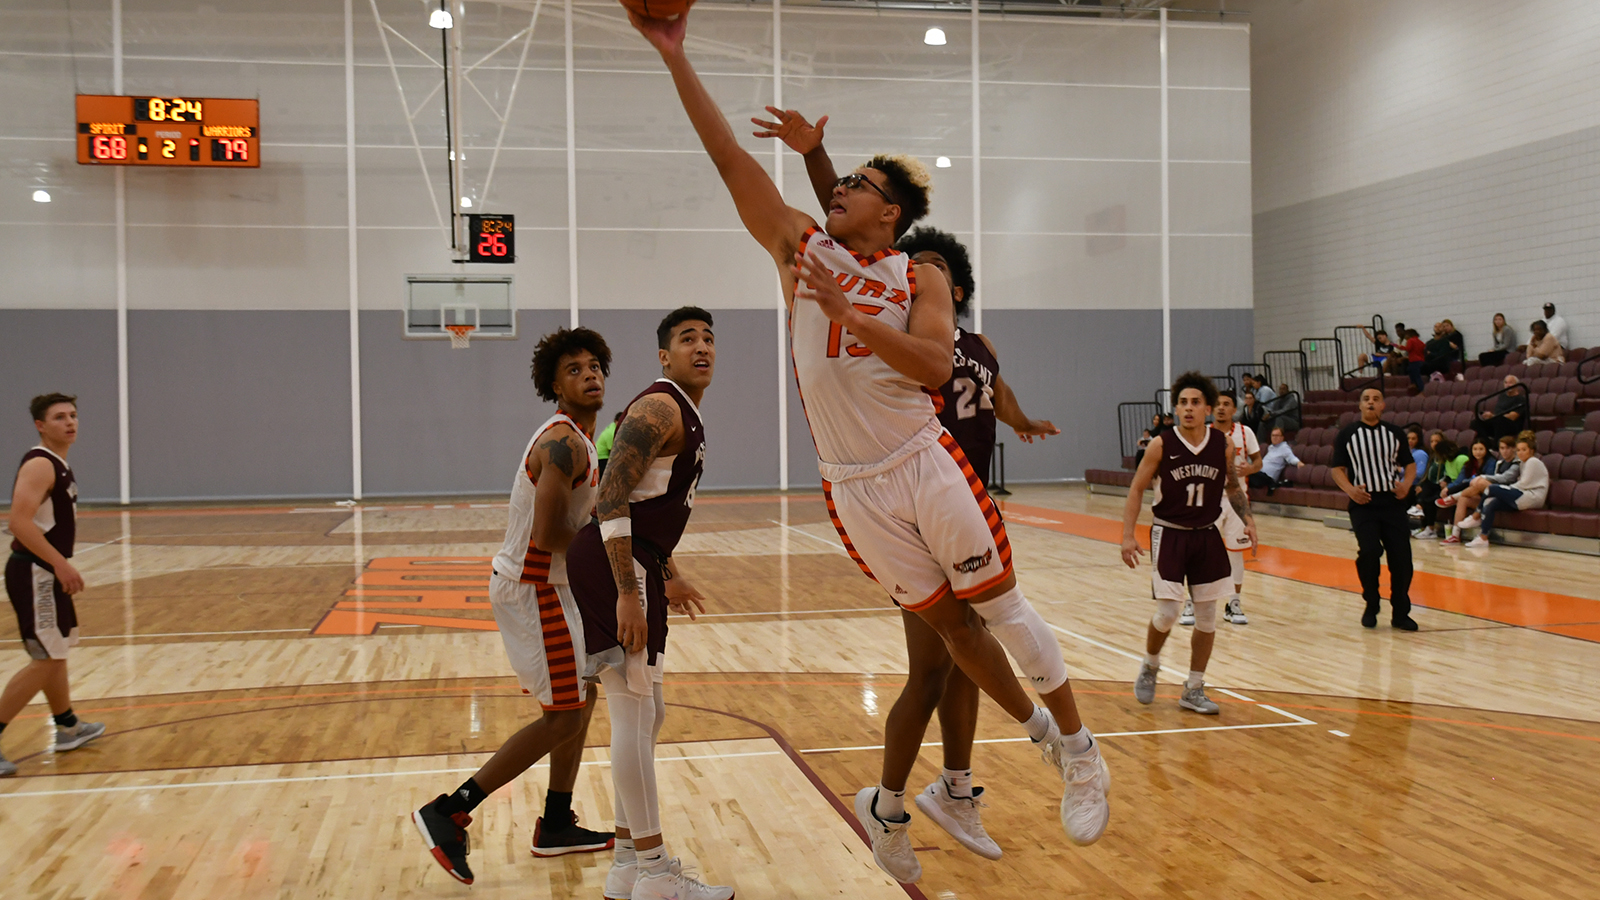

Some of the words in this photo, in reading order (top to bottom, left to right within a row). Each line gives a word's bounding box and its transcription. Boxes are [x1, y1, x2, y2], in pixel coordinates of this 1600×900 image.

[149, 98, 203, 122] 8:24
[90, 122, 127, 135] SPIRIT
[203, 125, 252, 138] WARRIORS
[93, 136, 127, 160] 68
[162, 139, 176, 159] 2
[218, 138, 248, 161] 79
[477, 233, 508, 257] 26
[1169, 464, 1220, 482] WESTMONT
[1186, 483, 1205, 507] 11
